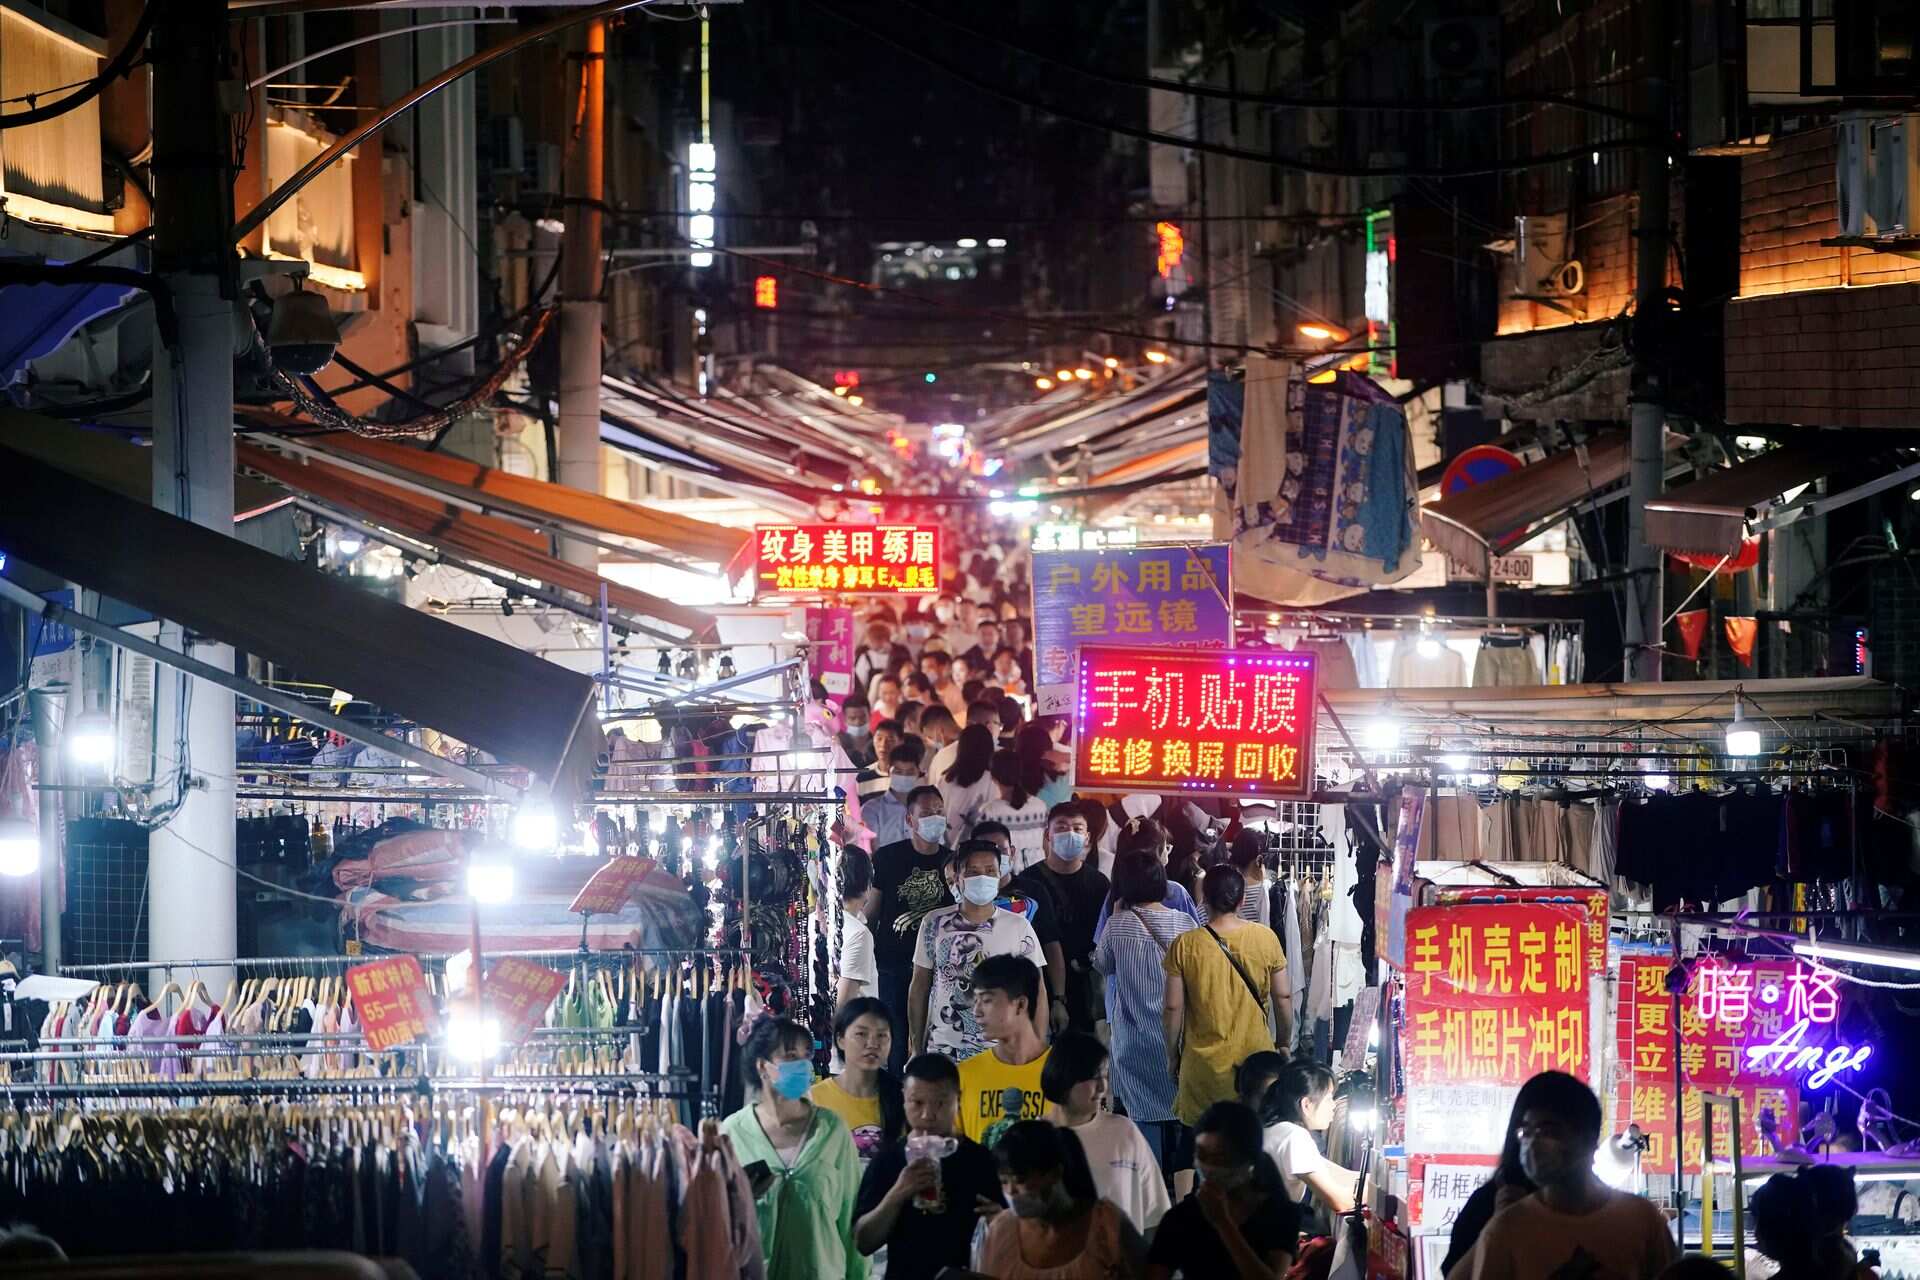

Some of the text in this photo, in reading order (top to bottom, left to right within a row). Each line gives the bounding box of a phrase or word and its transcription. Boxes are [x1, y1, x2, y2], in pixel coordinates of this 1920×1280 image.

[761, 530, 934, 564] 纹身 美甲 绣眉
[1050, 559, 1217, 595] 户外用品
[1069, 599, 1198, 636] 望远镜
[1092, 667, 1300, 733] 手机贴膜
[1090, 737, 1297, 781] 维修 换屏 回收
[1414, 920, 1581, 996] 手机壳定制
[1587, 893, 1606, 971] 充电宝
[353, 962, 416, 997] 新款特价
[1414, 1007, 1583, 1081] 手机照片冲印
[1747, 1018, 1871, 1089] Ange
